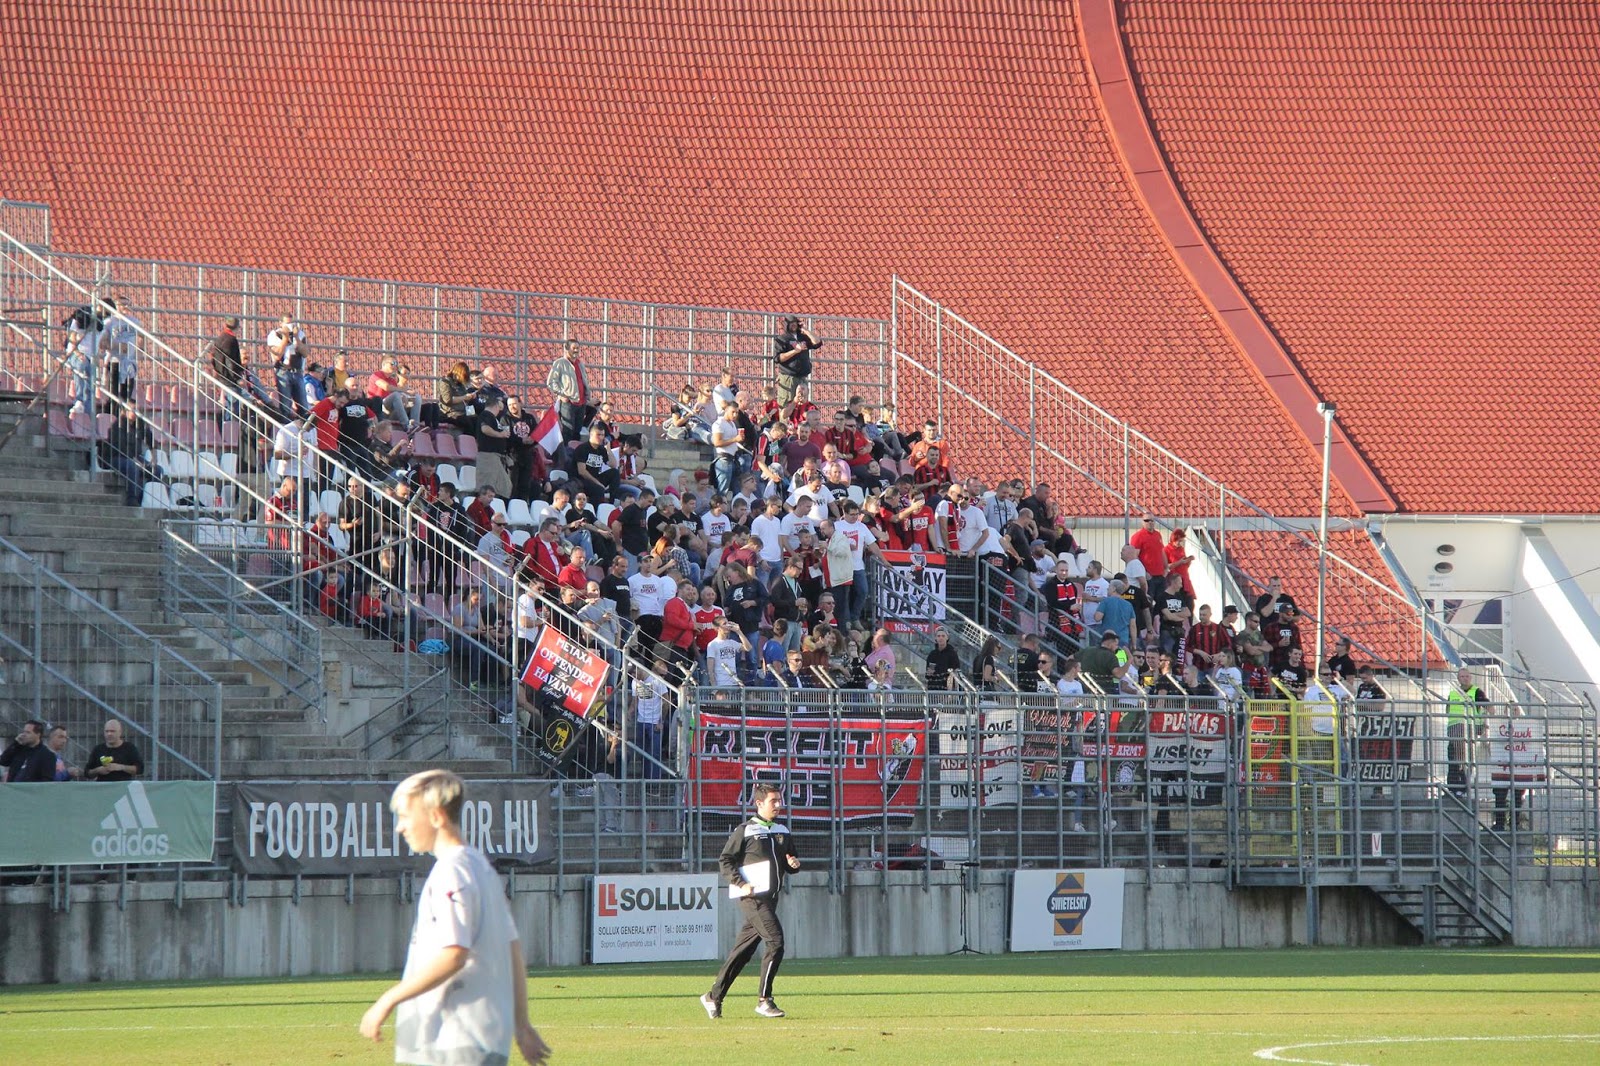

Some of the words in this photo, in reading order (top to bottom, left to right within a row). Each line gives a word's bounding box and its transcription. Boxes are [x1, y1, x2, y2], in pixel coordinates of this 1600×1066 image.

[556, 636, 593, 666] METAXA
[540, 646, 595, 688] OFFENDER
[532, 665, 583, 704] HAVANNA
[92, 828, 169, 857] adidas
[249, 800, 539, 859] FOOTBALLOR.HU
[620, 887, 713, 911] SOLLUX
[1051, 896, 1088, 911] SWIETELSKY
[598, 926, 620, 935] SOLLUX
[620, 925, 646, 935] GENERAL
